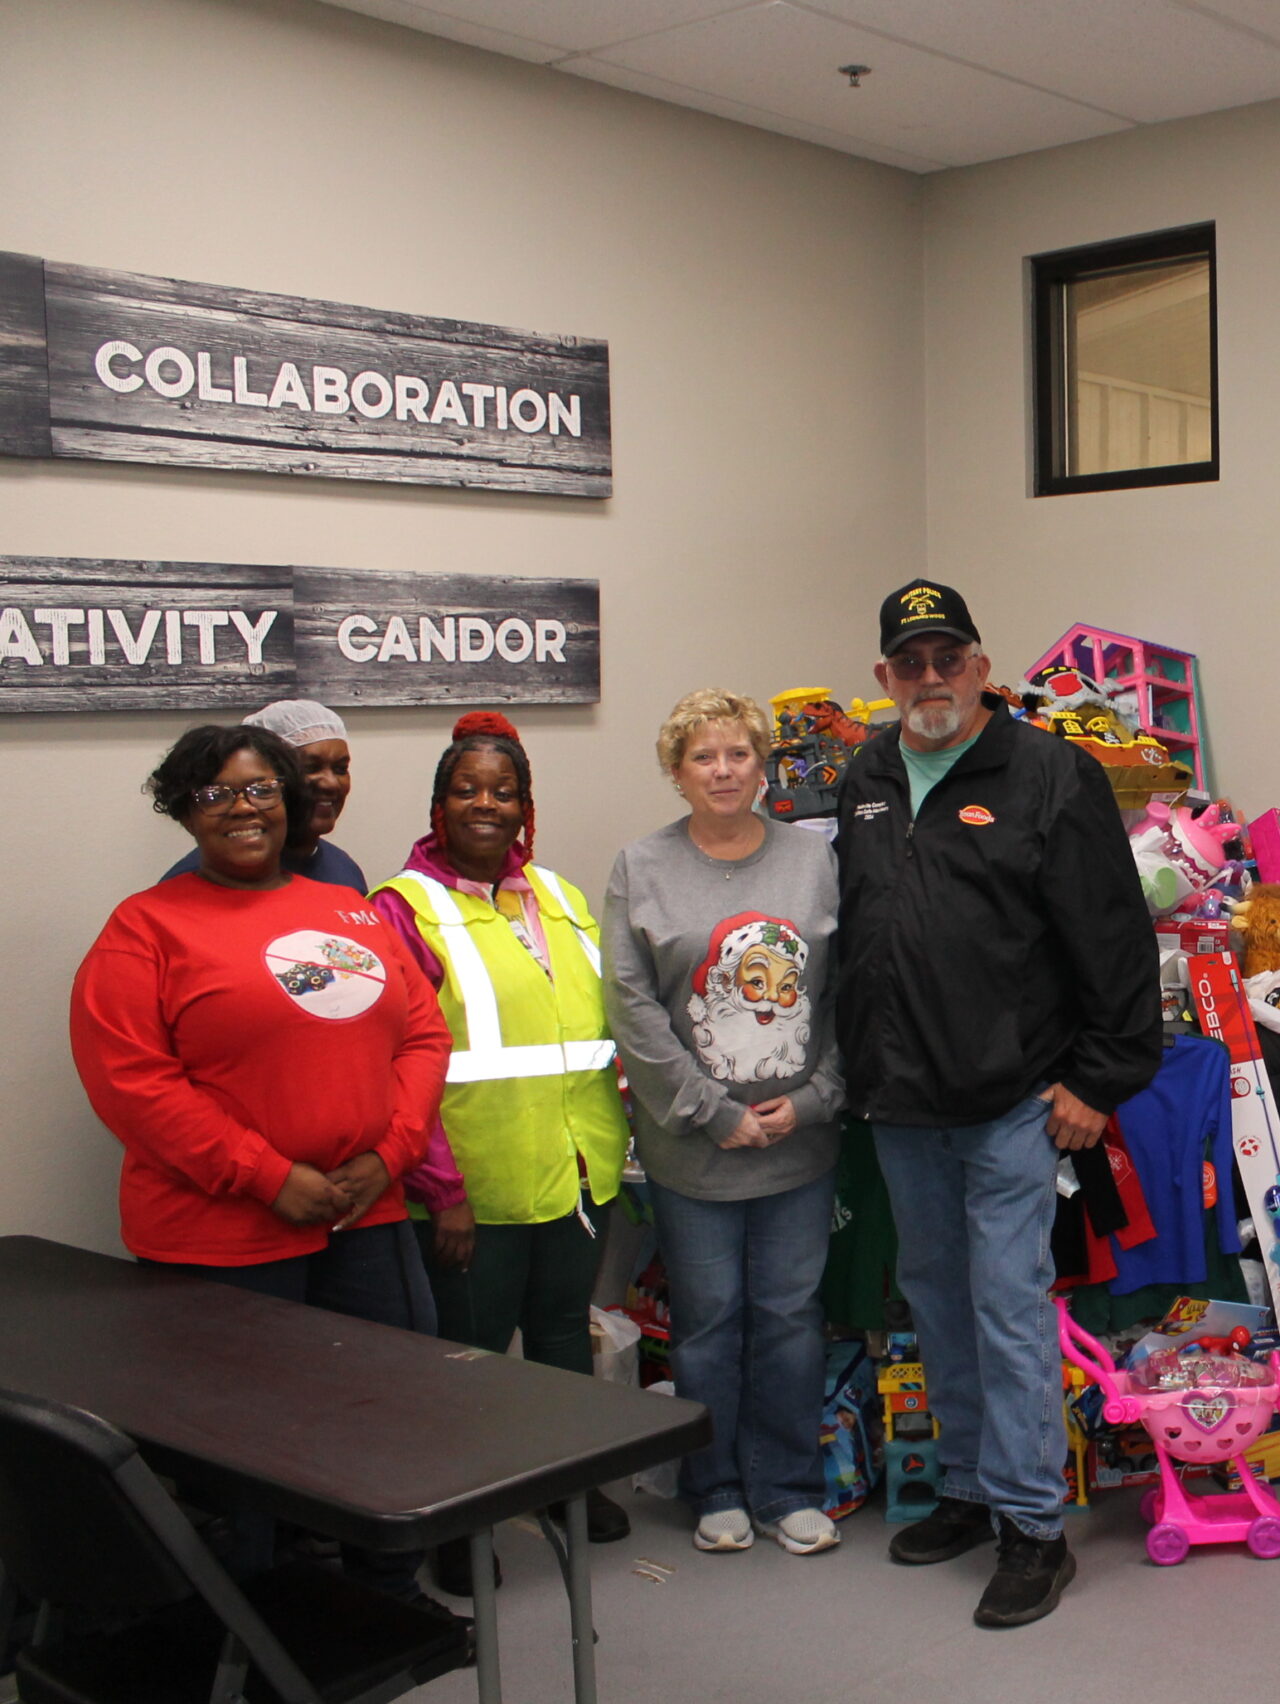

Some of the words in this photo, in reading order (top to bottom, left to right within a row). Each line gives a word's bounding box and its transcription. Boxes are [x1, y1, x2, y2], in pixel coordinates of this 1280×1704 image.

[94, 340, 582, 437] COLLABORATION
[0, 607, 278, 666] ATIVITY
[337, 614, 567, 663] CANDOR
